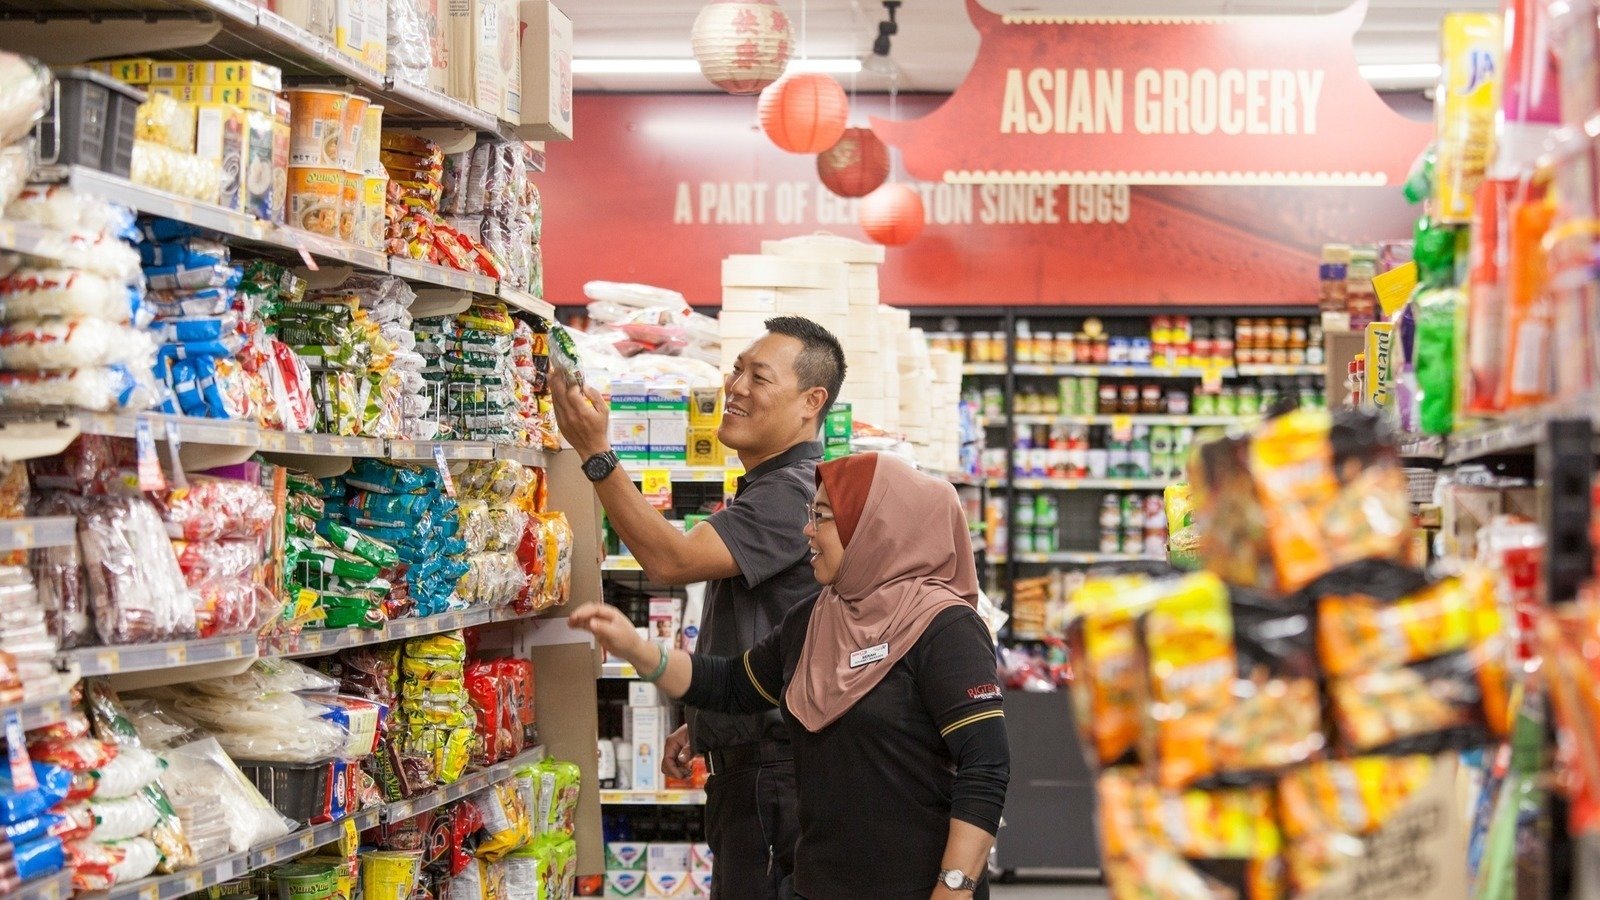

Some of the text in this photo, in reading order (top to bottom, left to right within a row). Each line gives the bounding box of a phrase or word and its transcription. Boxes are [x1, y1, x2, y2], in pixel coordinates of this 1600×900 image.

[1001, 68, 1325, 135] ASIAN GROCERY
[674, 182, 693, 224] A
[701, 182, 768, 224] PART
[776, 182, 810, 224] OF
[979, 184, 1060, 224] SINCE
[1068, 184, 1131, 224] 1969
[1373, 330, 1389, 410] Custard
